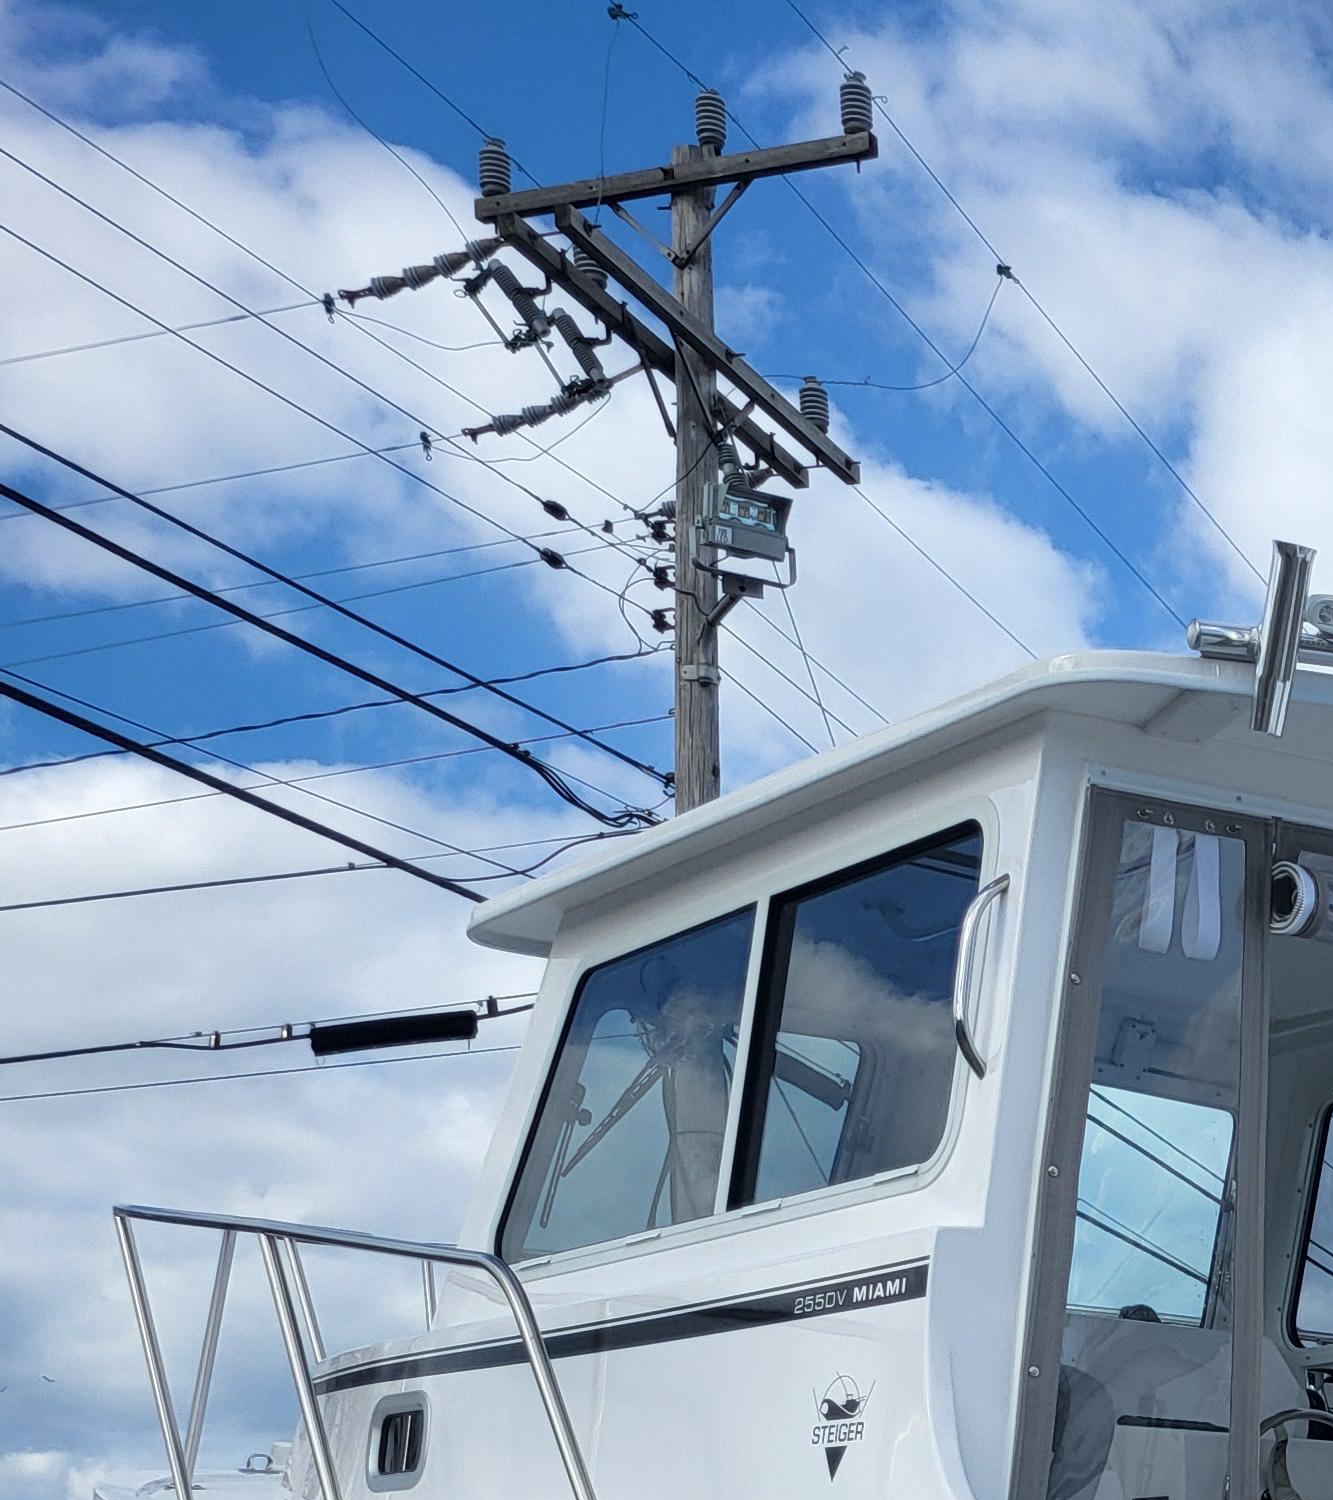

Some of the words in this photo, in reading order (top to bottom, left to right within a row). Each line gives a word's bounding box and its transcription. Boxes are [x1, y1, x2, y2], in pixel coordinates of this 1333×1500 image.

[794, 1289, 848, 1314] 255DV
[852, 1277, 907, 1303] MIAMI
[811, 1421, 865, 1445] STEIGER
